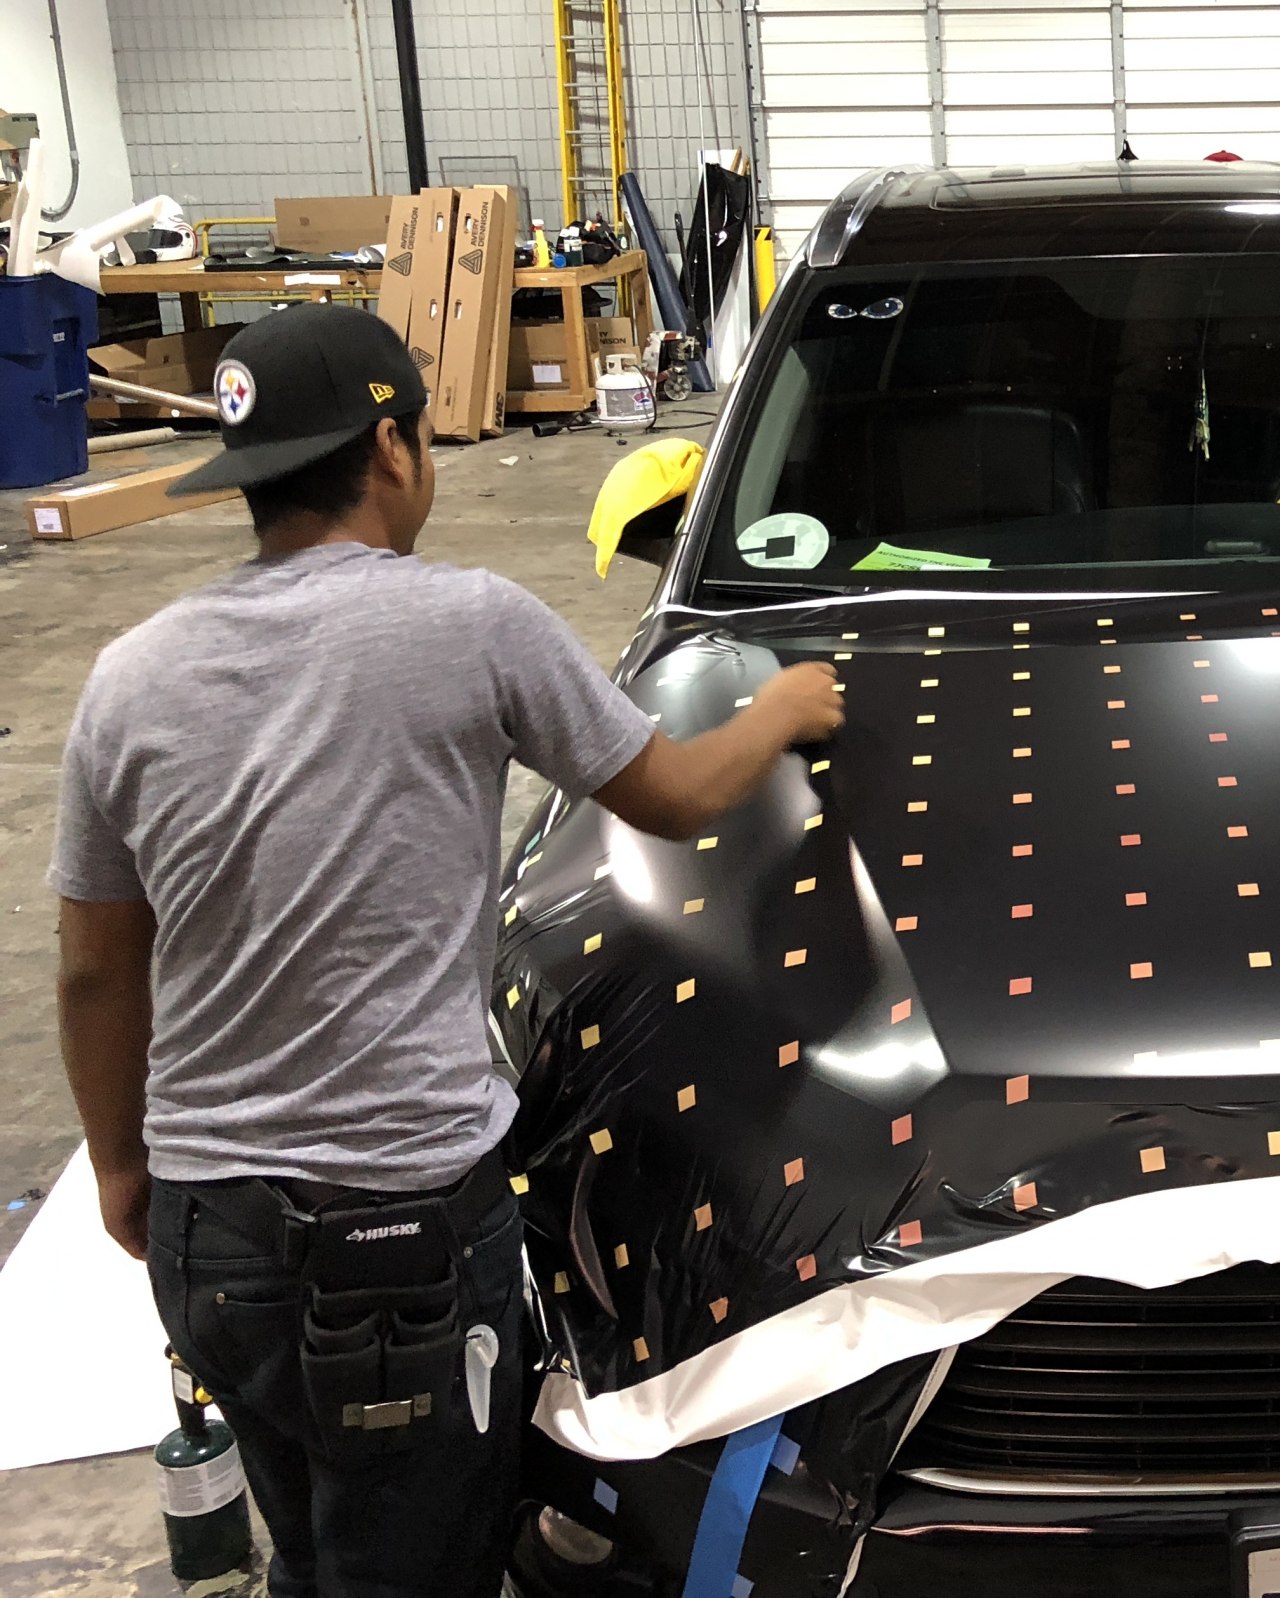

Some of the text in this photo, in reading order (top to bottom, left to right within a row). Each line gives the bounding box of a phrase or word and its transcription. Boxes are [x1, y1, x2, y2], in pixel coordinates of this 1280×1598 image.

[400, 222, 409, 249] AVERY
[407, 207, 419, 250] DENNISON
[471, 218, 479, 246] AVERY
[478, 201, 488, 247] DENNISON
[600, 337, 626, 345] NISON
[495, 391, 504, 429] 3M
[366, 1222, 421, 1241] HUSKY
